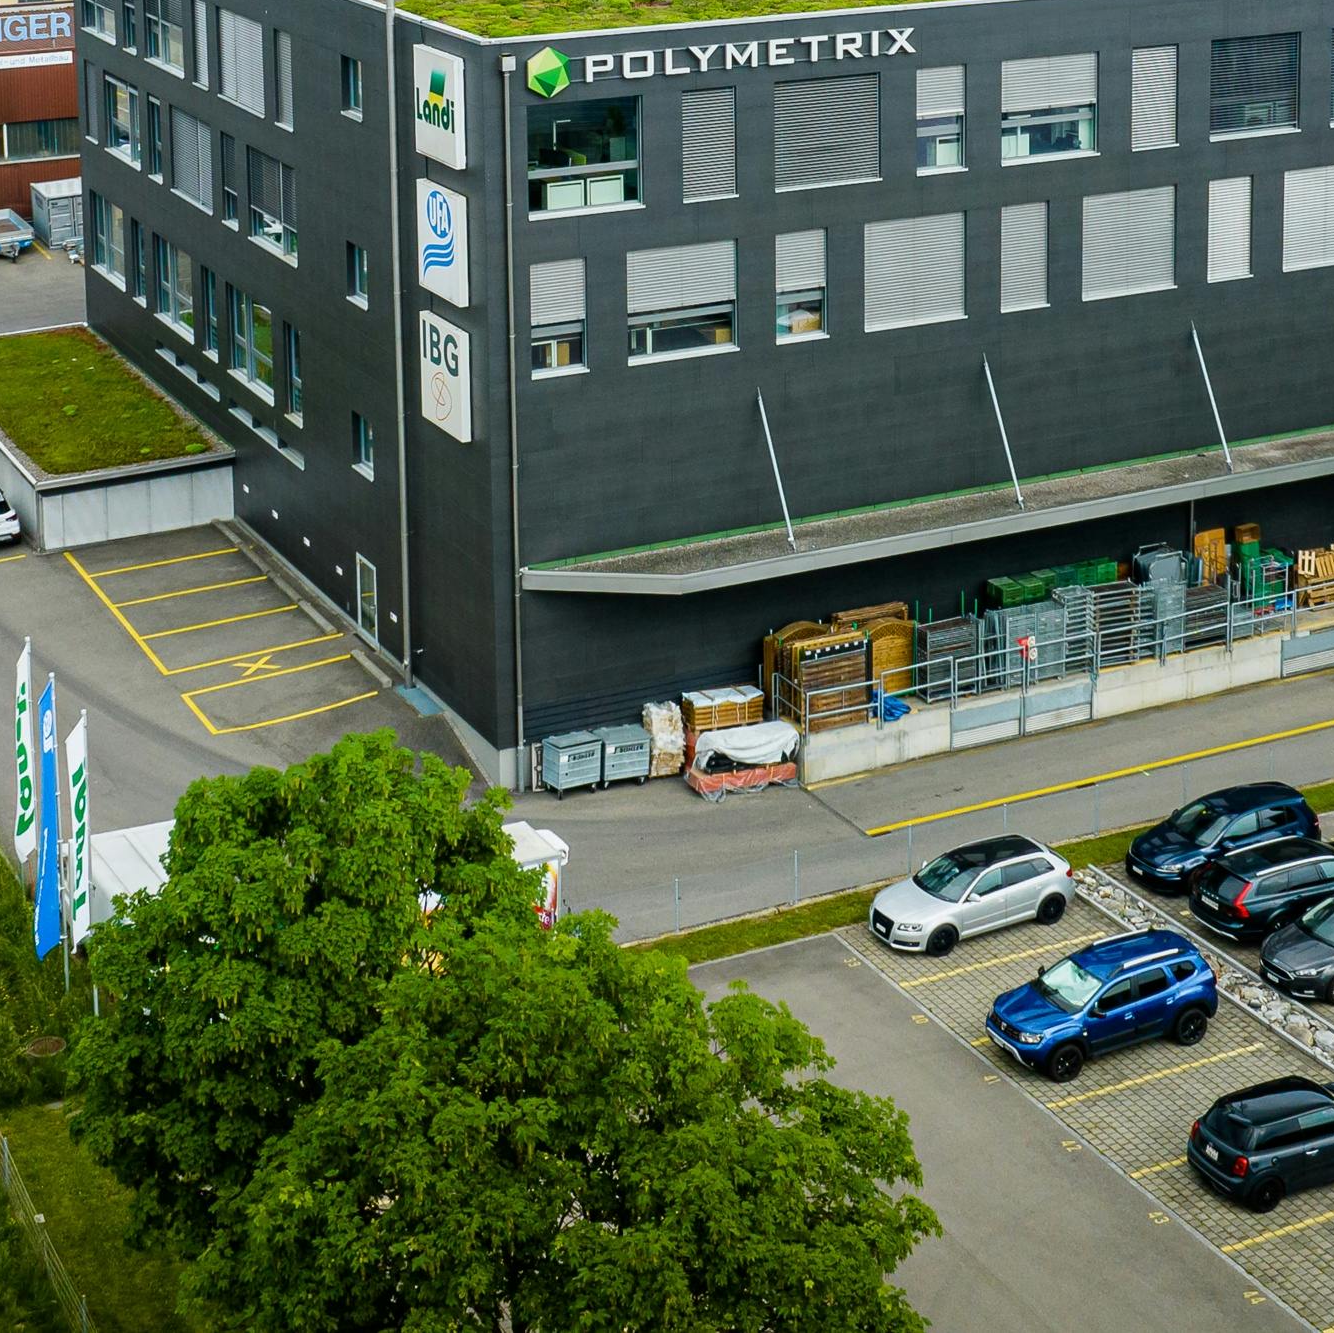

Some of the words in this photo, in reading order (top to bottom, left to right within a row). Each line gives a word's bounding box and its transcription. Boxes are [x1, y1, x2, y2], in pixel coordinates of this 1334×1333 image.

[585, 27, 916, 83] POLYMETRIX
[416, 87, 455, 134] Landi
[429, 193, 450, 235] UFA
[422, 319, 459, 377] IBG
[1147, 1211, 1170, 1225] 43
[1242, 1290, 1267, 1305] 44
